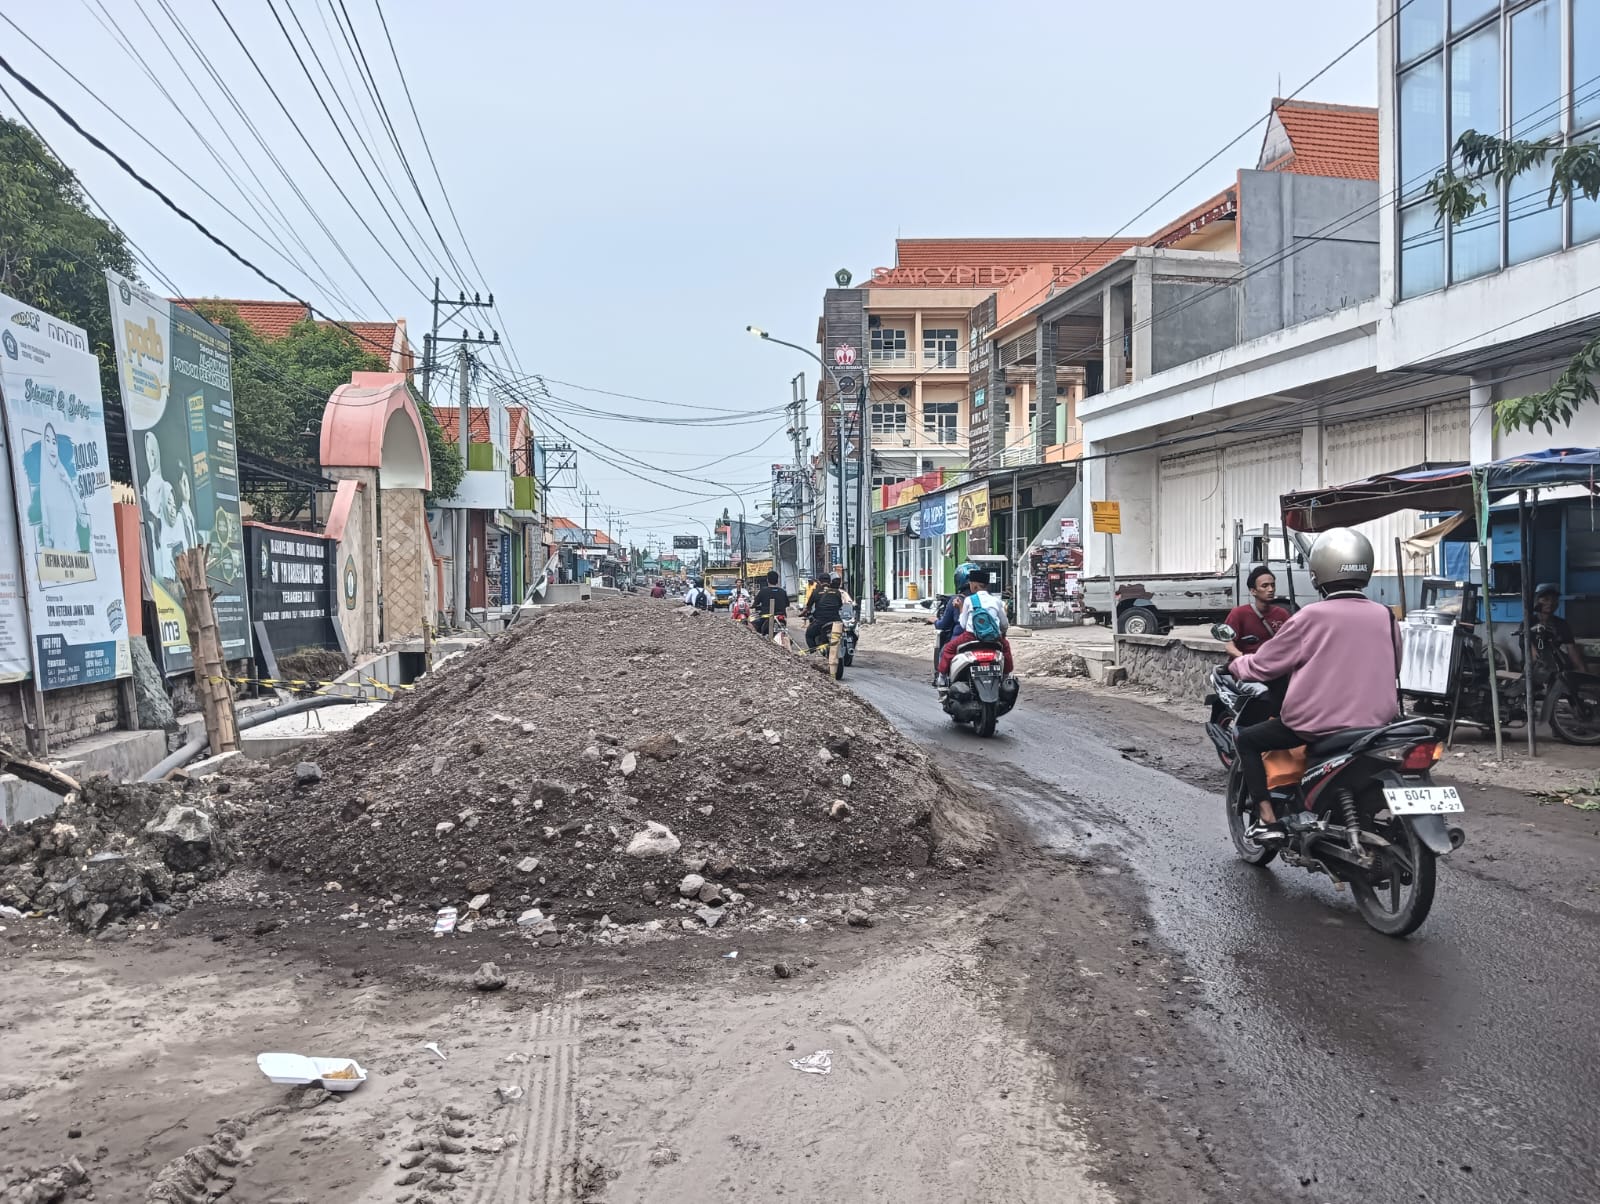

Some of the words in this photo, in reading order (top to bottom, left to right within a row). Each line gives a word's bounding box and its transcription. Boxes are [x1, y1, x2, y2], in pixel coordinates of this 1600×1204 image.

[872, 266, 930, 285] SMK
[938, 265, 980, 285] YPI
[124, 317, 164, 367] ppdb
[25, 379, 56, 409] Selamat
[57, 391, 66, 412] &
[75, 441, 98, 471] LOLOS
[78, 472, 96, 499] SNBP
[1387, 791, 1396, 801] W
[1404, 789, 1431, 801] 6047
